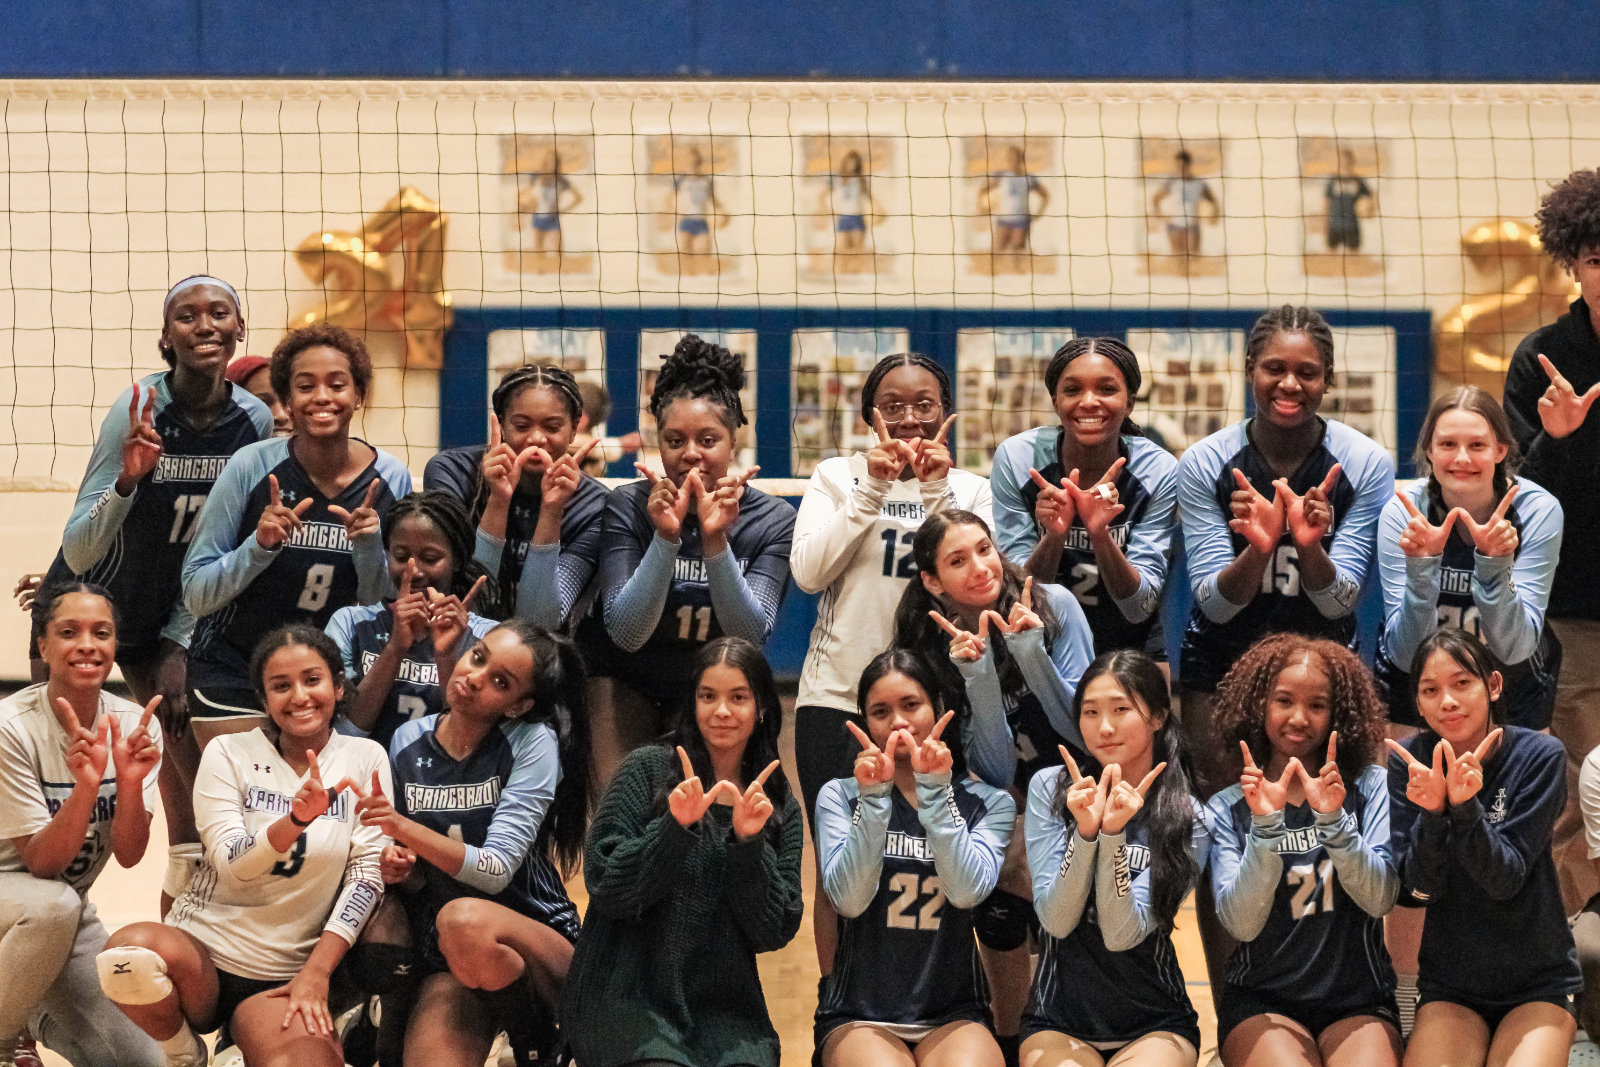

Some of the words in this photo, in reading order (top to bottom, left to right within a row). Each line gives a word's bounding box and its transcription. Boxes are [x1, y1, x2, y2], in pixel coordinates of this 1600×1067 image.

[170, 495, 208, 543] 17
[297, 563, 335, 612] 8
[1071, 563, 1099, 606] 2
[677, 604, 711, 642] 11
[406, 778, 500, 814] SPRINGBROOK
[271, 832, 308, 877] 3
[886, 872, 946, 930] 22
[1287, 859, 1334, 920] 21
